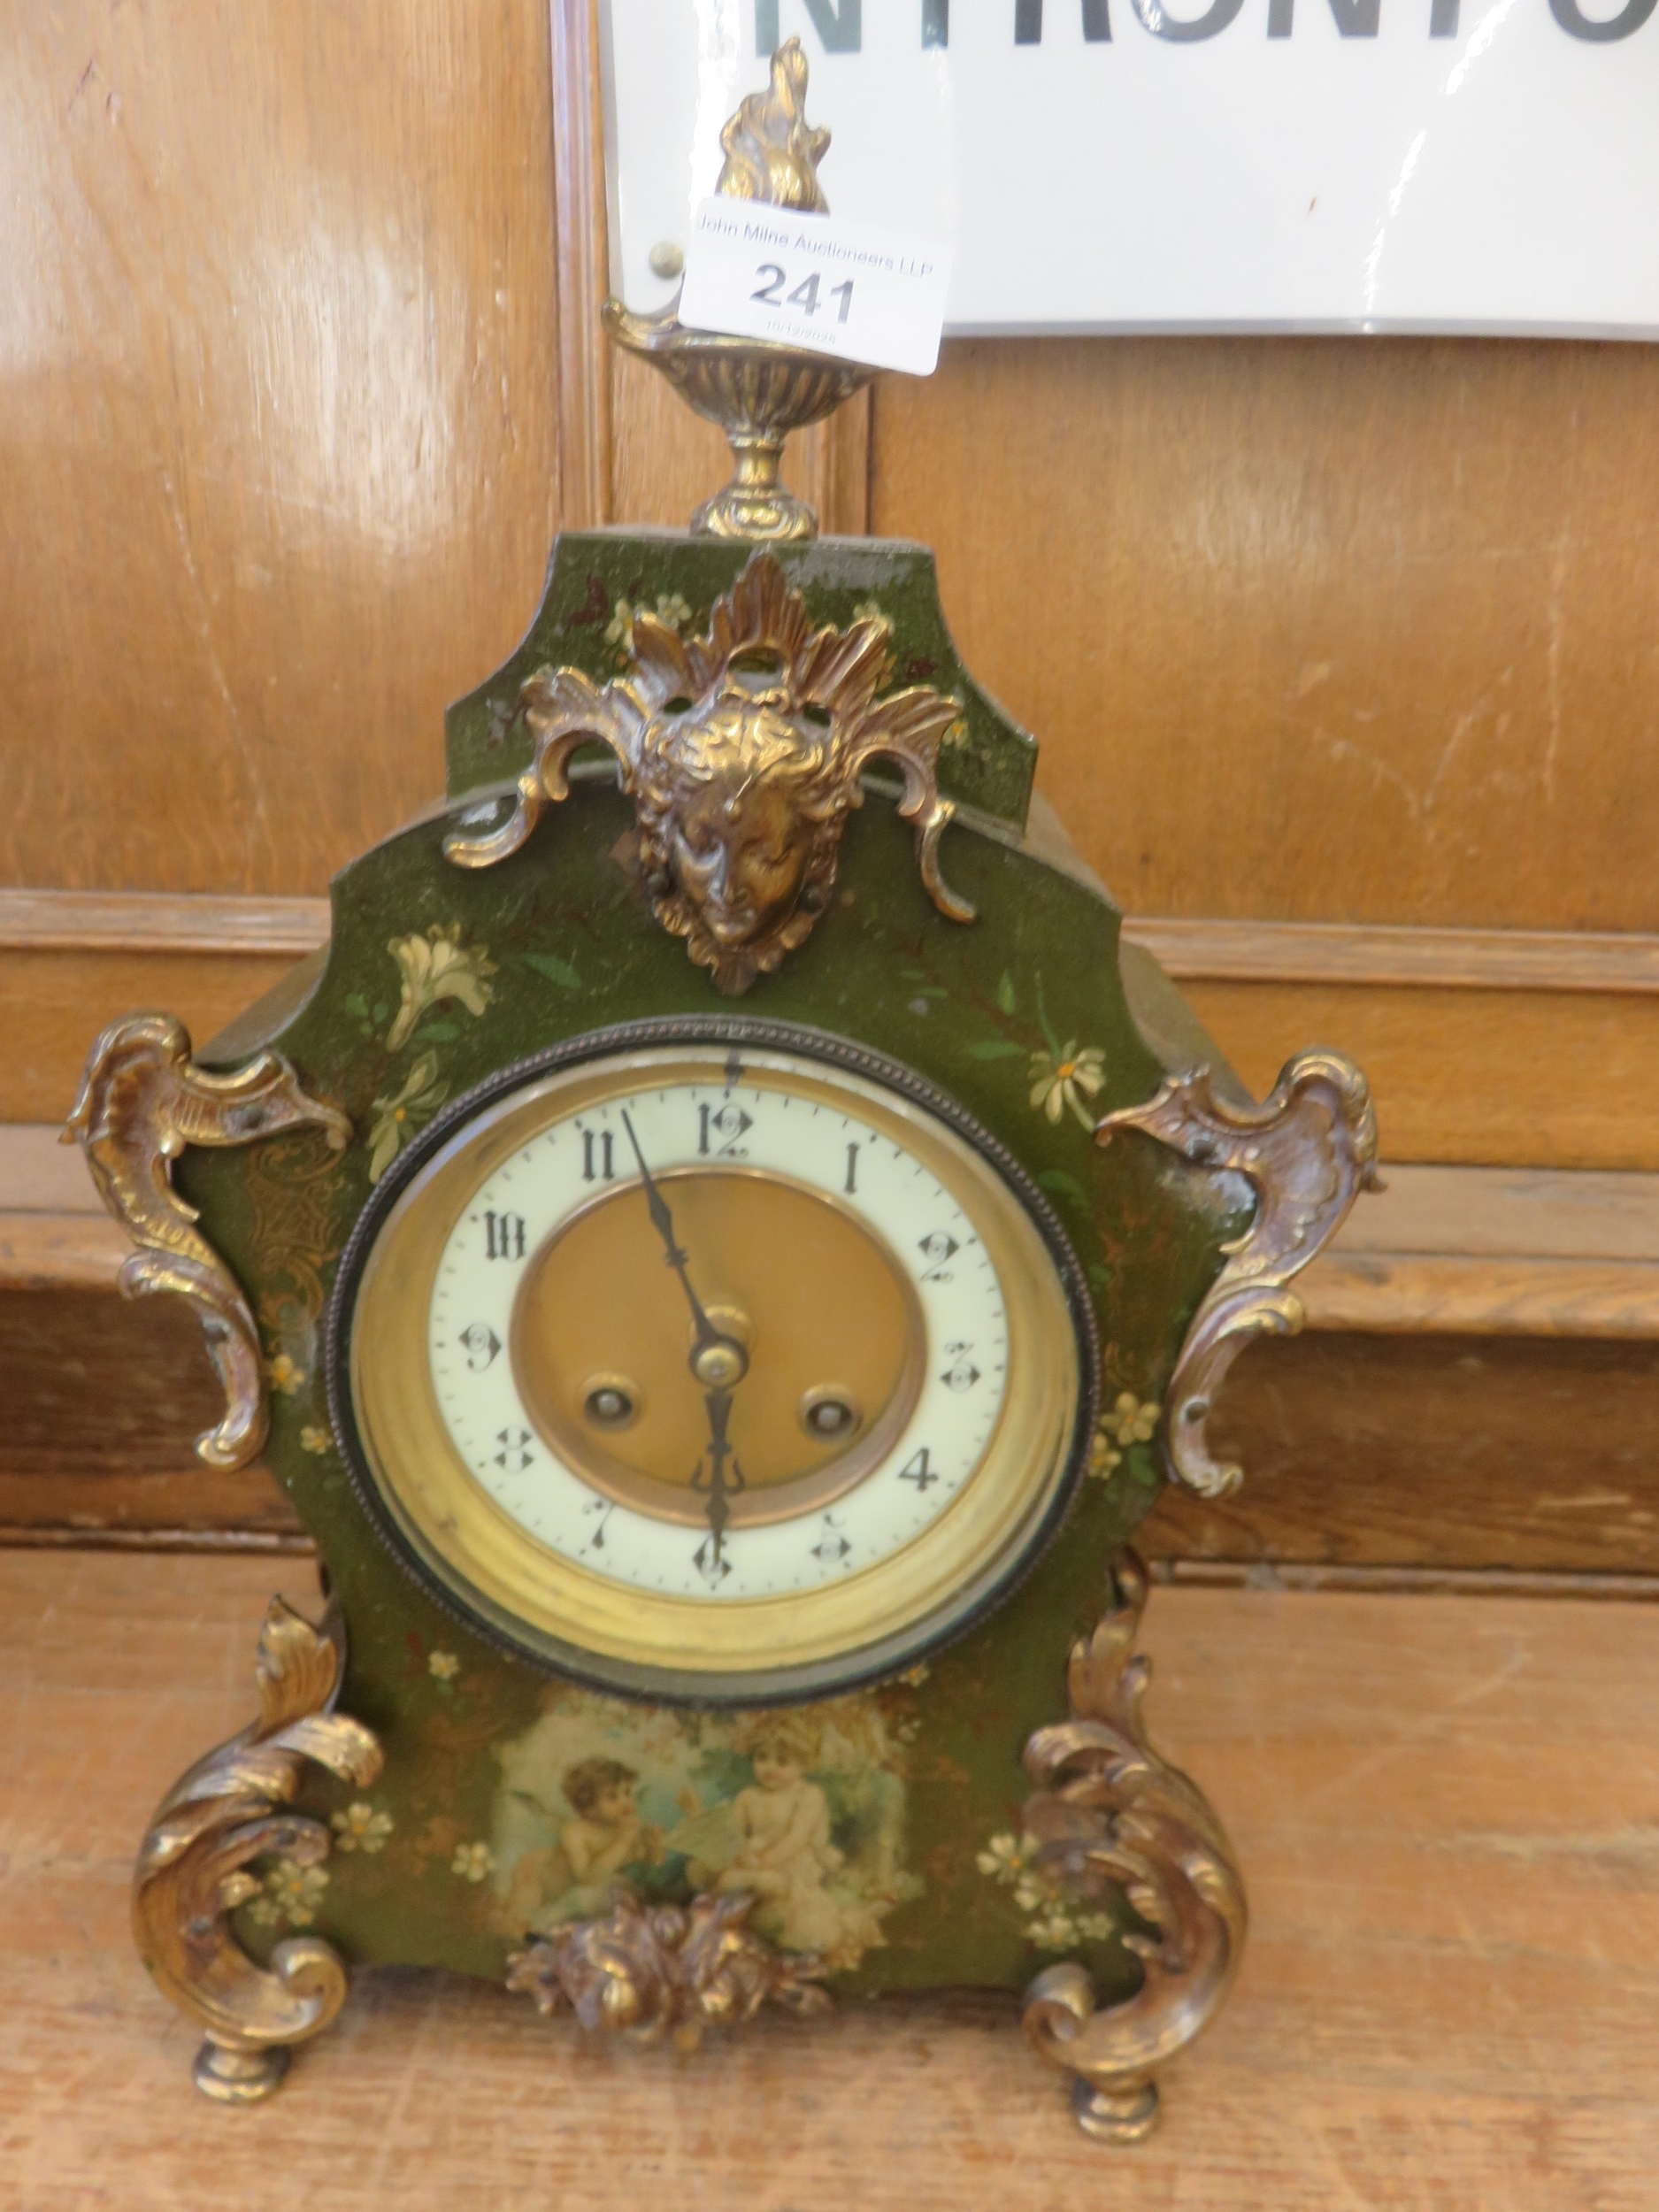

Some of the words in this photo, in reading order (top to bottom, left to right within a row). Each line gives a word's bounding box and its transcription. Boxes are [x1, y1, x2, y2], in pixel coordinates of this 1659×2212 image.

[696, 215, 738, 238] John
[743, 220, 789, 249] Milne
[794, 233, 894, 271] Auctioneers
[899, 257, 933, 280] LLP
[749, 263, 856, 325] 241
[582, 1129, 614, 1183] 11
[697, 1103, 754, 1158] 12
[844, 1141, 861, 1194] 1
[484, 1210, 526, 1263] 10
[917, 1232, 960, 1284] 2
[458, 1322, 502, 1372] 9
[940, 1340, 981, 1393] 3
[494, 1424, 534, 1475] 8
[897, 1447, 940, 1493] 4
[582, 1501, 617, 1549] 7
[810, 1510, 851, 1564] 5
